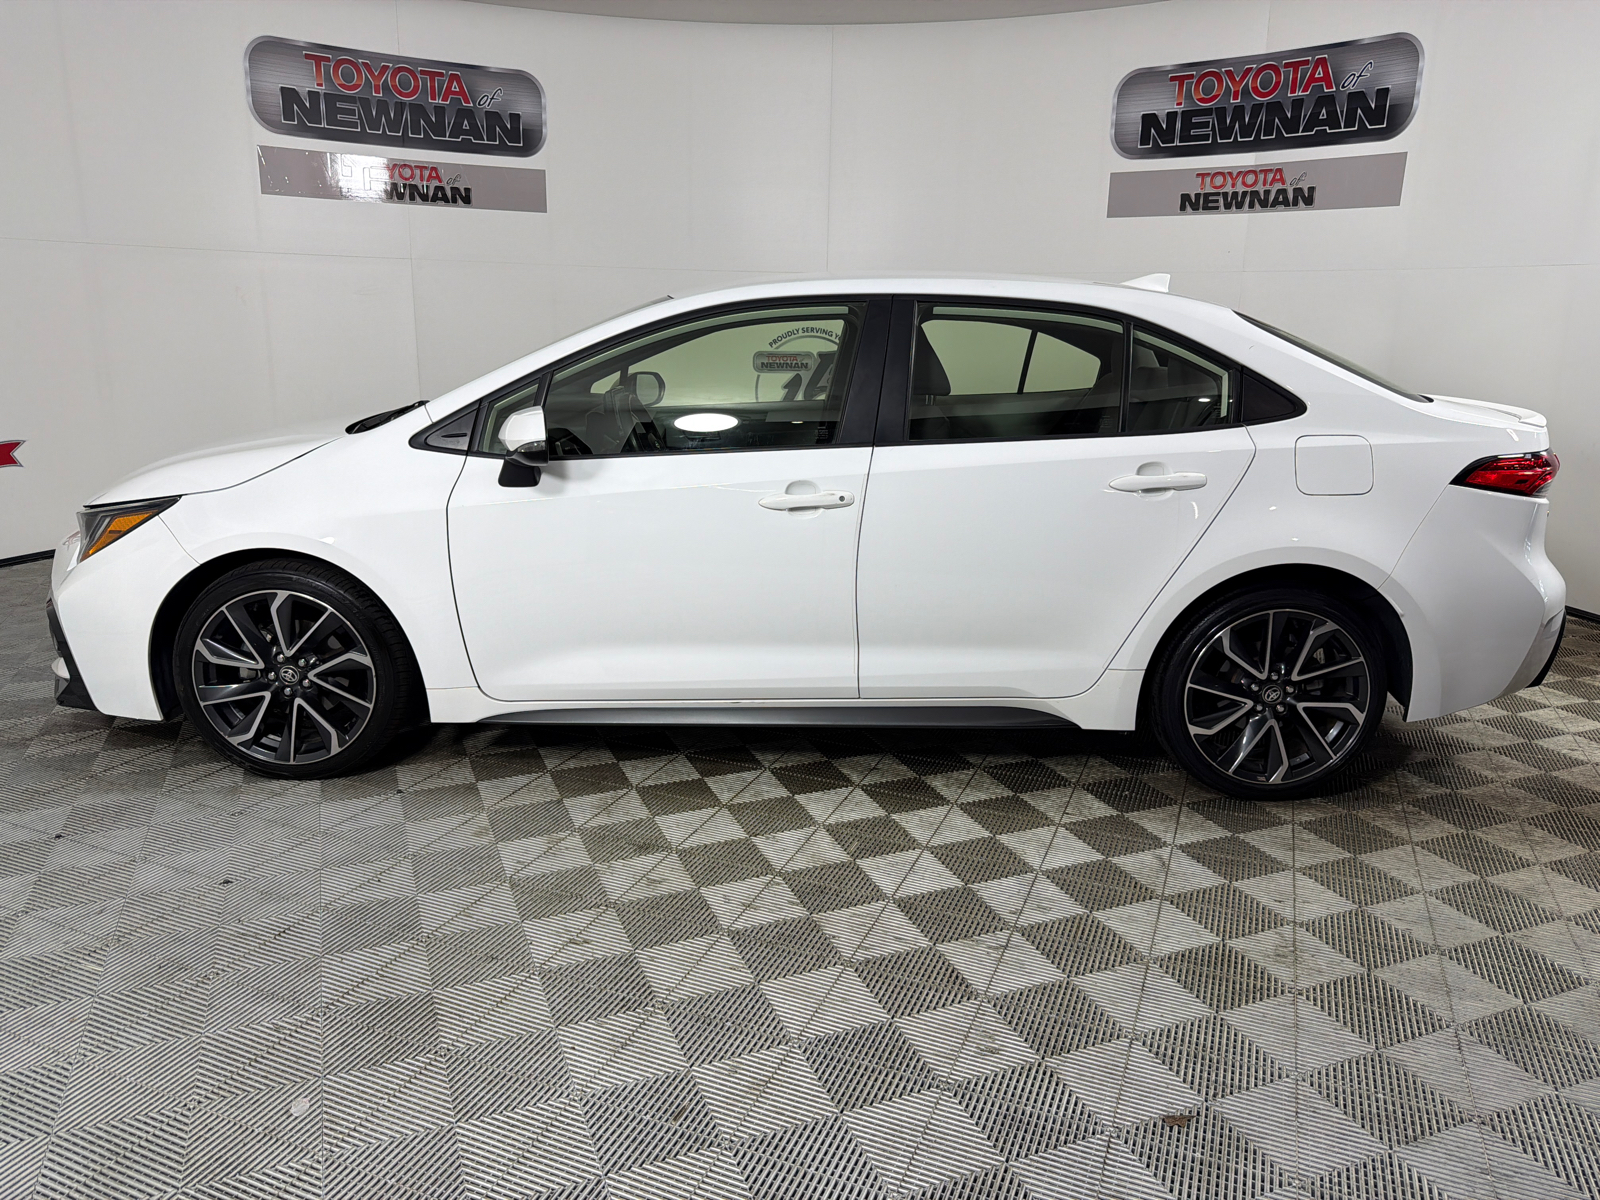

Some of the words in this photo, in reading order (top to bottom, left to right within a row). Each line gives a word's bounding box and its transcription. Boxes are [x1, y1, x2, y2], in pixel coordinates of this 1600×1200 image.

[303, 51, 472, 106] TOYOTA
[476, 87, 504, 108] of
[1168, 55, 1335, 107] TOYOTA
[1340, 60, 1373, 90] of
[279, 85, 523, 146] NEWNAN
[1138, 86, 1391, 148] NEWNAN
[385, 163, 443, 184] YOTA
[1196, 167, 1286, 191] TOYOTA
[1289, 172, 1307, 187] of
[386, 182, 473, 206] WNAN
[1179, 186, 1316, 212] NEWNAN
[768, 327, 800, 348] PROUDLY
[801, 326, 833, 337] SERVING
